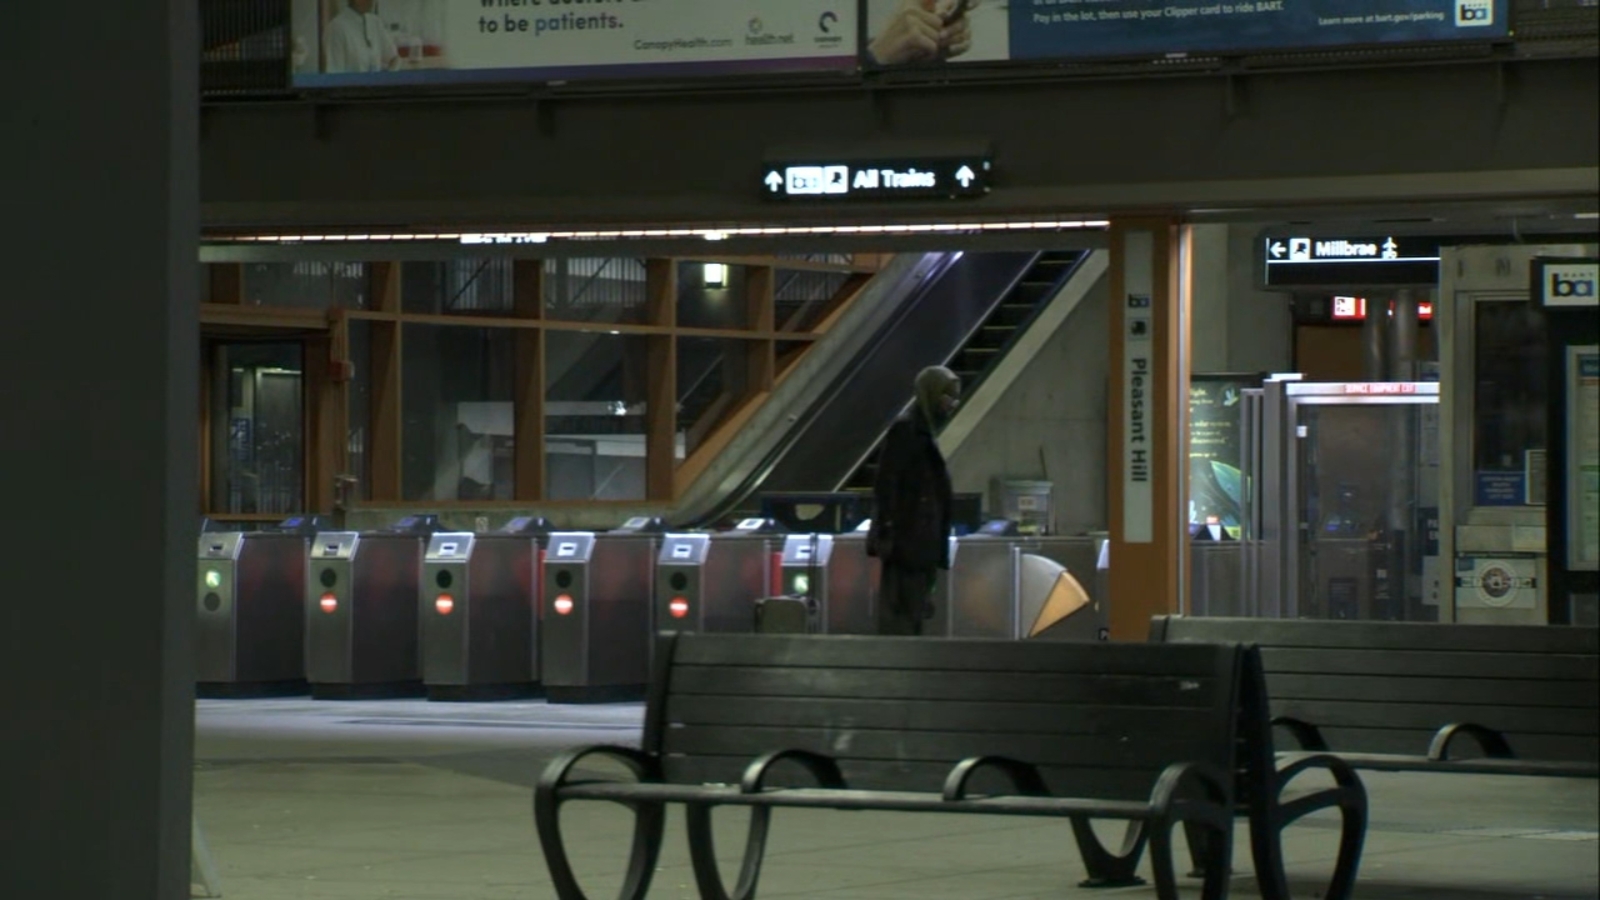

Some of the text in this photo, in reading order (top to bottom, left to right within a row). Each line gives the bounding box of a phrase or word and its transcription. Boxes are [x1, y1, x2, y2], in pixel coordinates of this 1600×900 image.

[1164, 6, 1198, 18] Clipper
[1200, 4, 1220, 15] card
[1222, 4, 1234, 14] to
[1235, 2, 1254, 13] ride
[479, 12, 624, 36] to be patients.
[853, 167, 936, 189] All Trains
[1315, 240, 1377, 257] Millbrae
[1131, 358, 1148, 481] Pleasant Hill
